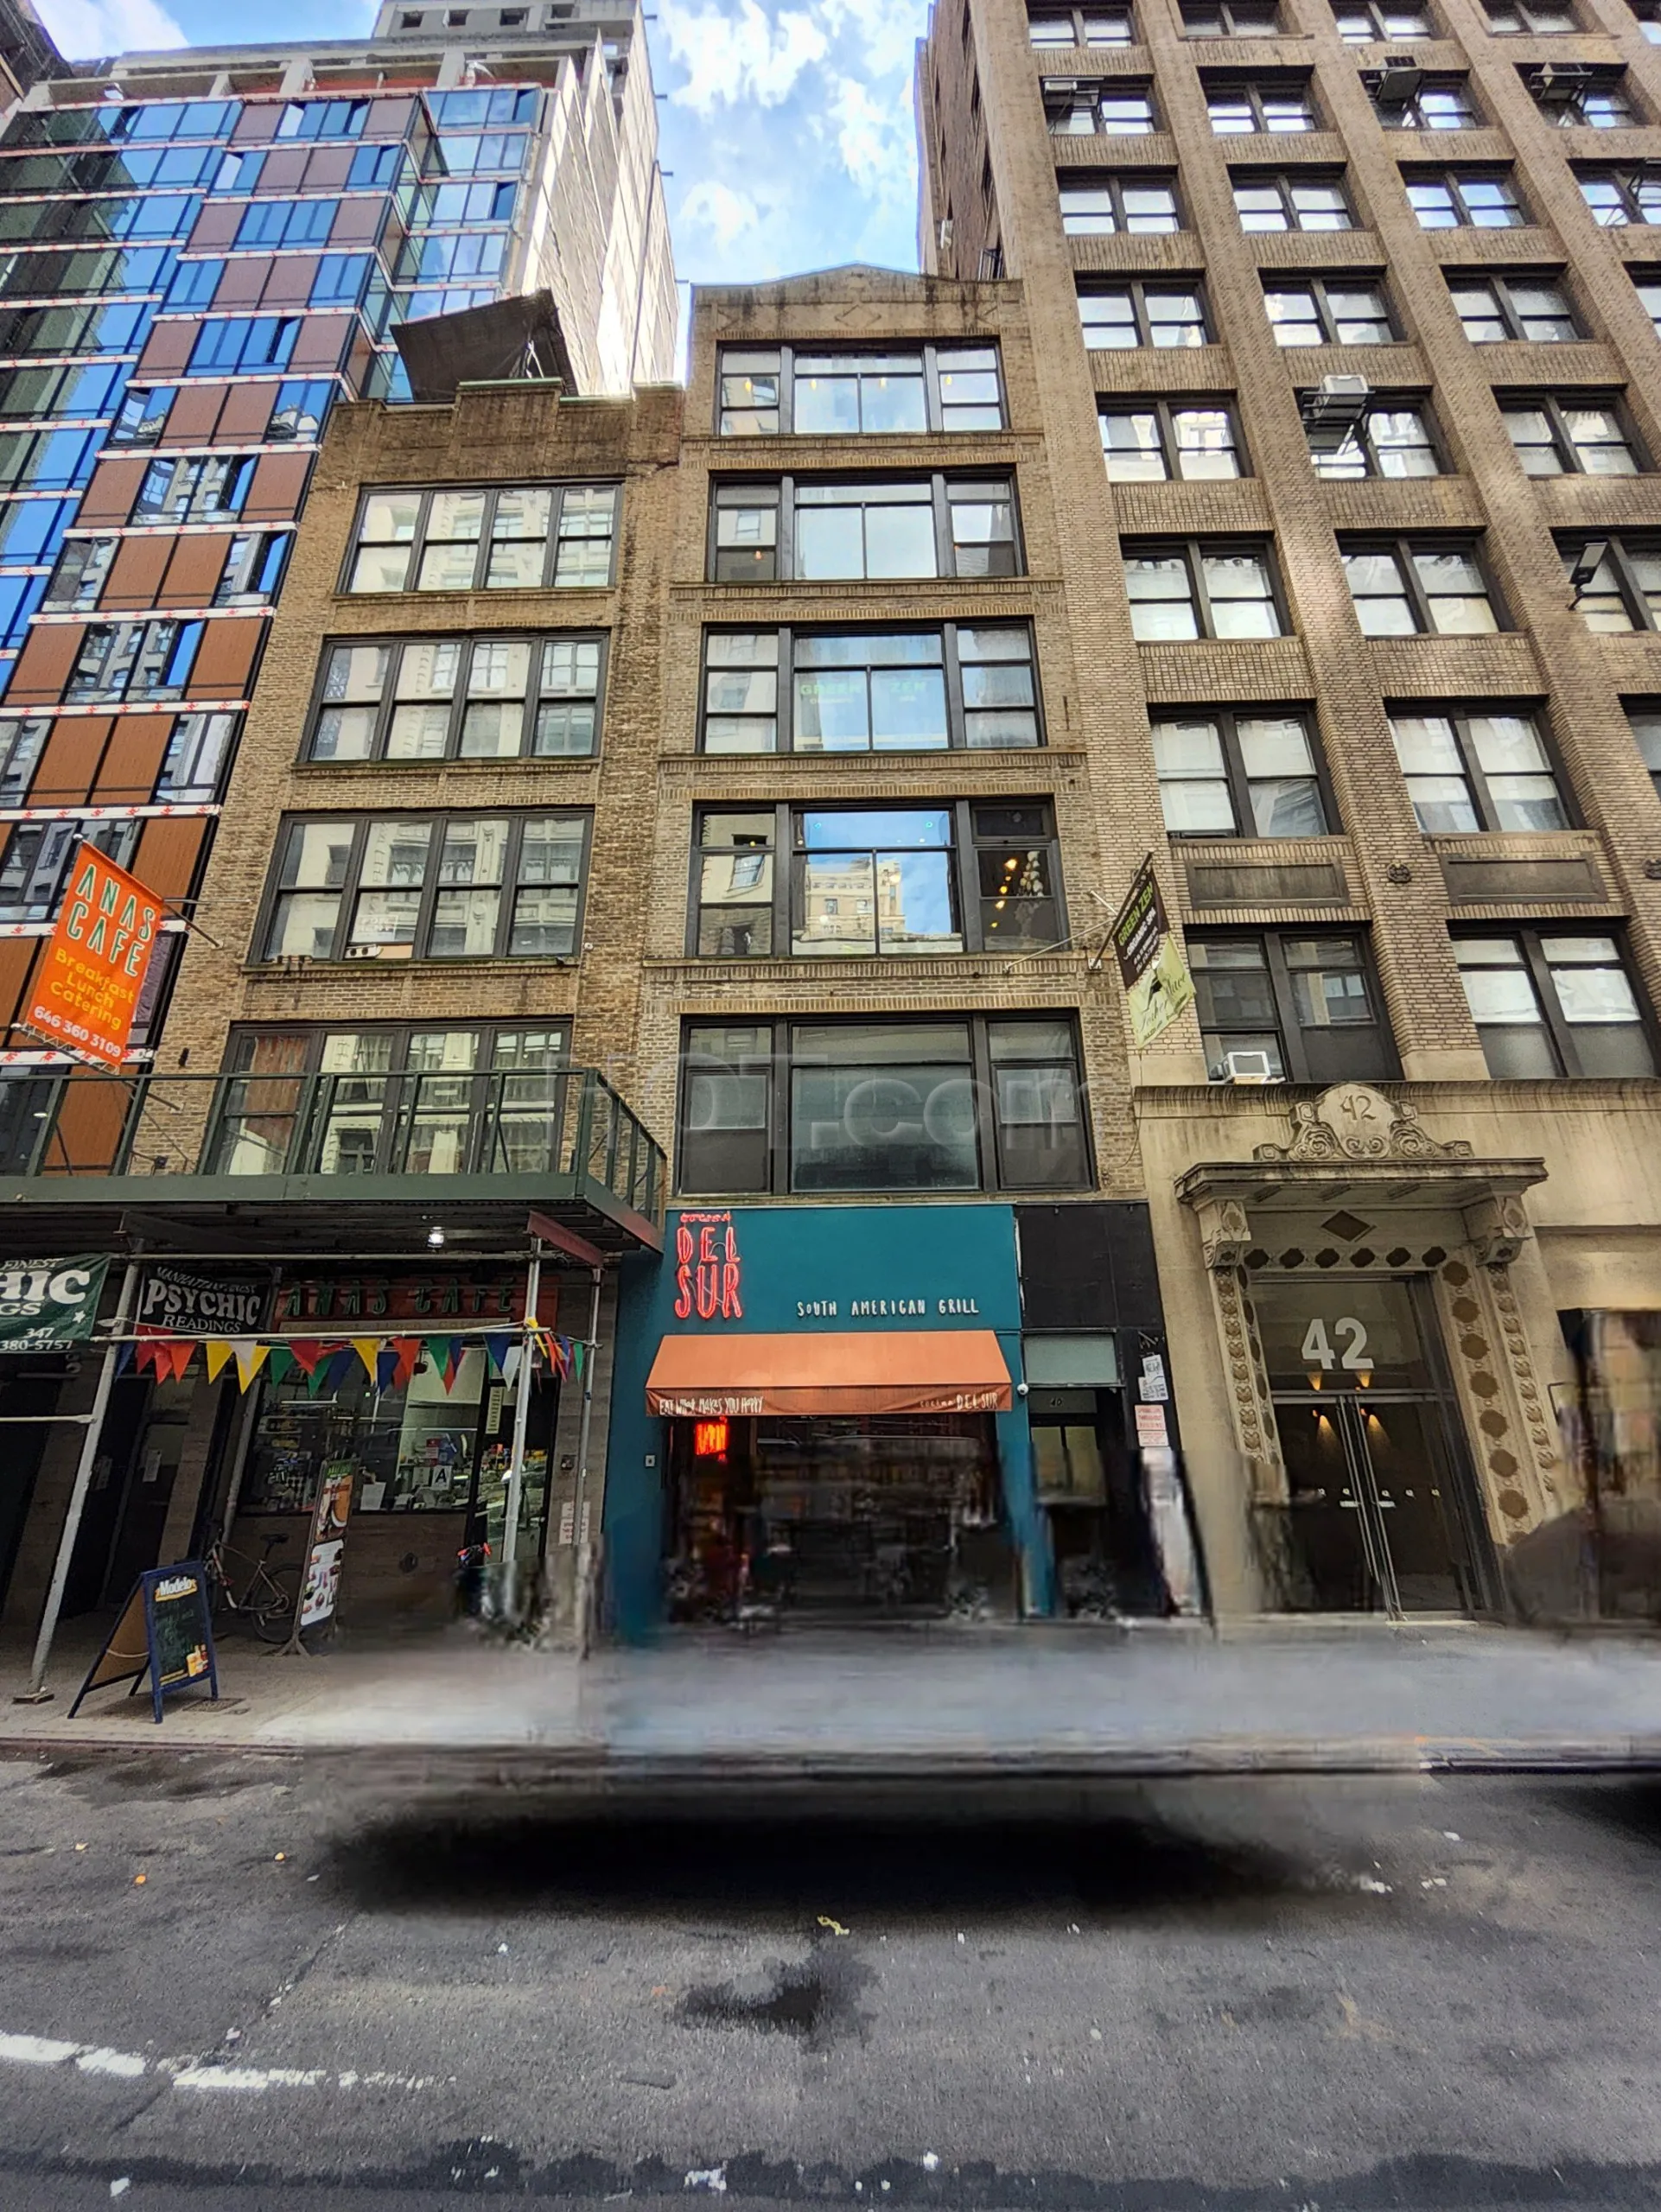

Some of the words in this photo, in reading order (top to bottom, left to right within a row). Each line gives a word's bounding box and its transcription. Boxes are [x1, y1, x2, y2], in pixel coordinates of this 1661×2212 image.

[75, 863, 156, 944] ANAS
[1118, 905, 1141, 946] GREEN
[1138, 880, 1154, 913] ZEN
[67, 901, 145, 977] CAFE
[54, 947, 135, 1004] Breakfast
[66, 972, 115, 1008] Lunch
[50, 982, 122, 1030] Catering
[34, 1006, 61, 1028] 646
[62, 1020, 90, 1042] 360
[90, 1033, 122, 1058] 3109
[1340, 1095, 1377, 1121] 42
[677, 1226, 741, 1263] DEL
[1, 1258, 66, 1270] FINEST
[143, 1279, 261, 1325] PSYCHIC
[283, 1278, 389, 1318] ANAS
[413, 1276, 515, 1314] CAFE
[675, 1263, 742, 1319] SUR
[797, 1300, 837, 1317] SOUTH
[851, 1300, 926, 1316] AMERICAN
[939, 1298, 980, 1314] GRILL
[24, 1327, 55, 1338] 347
[162, 1313, 242, 1334] READINGS
[0, 1340, 73, 1351] 380-5757
[1301, 1317, 1375, 1370] 42
[956, 1394, 978, 1410] DEL
[981, 1392, 998, 1409] SUR
[435, 1471, 448, 1484] A
[159, 1576, 194, 1596] Modelo
